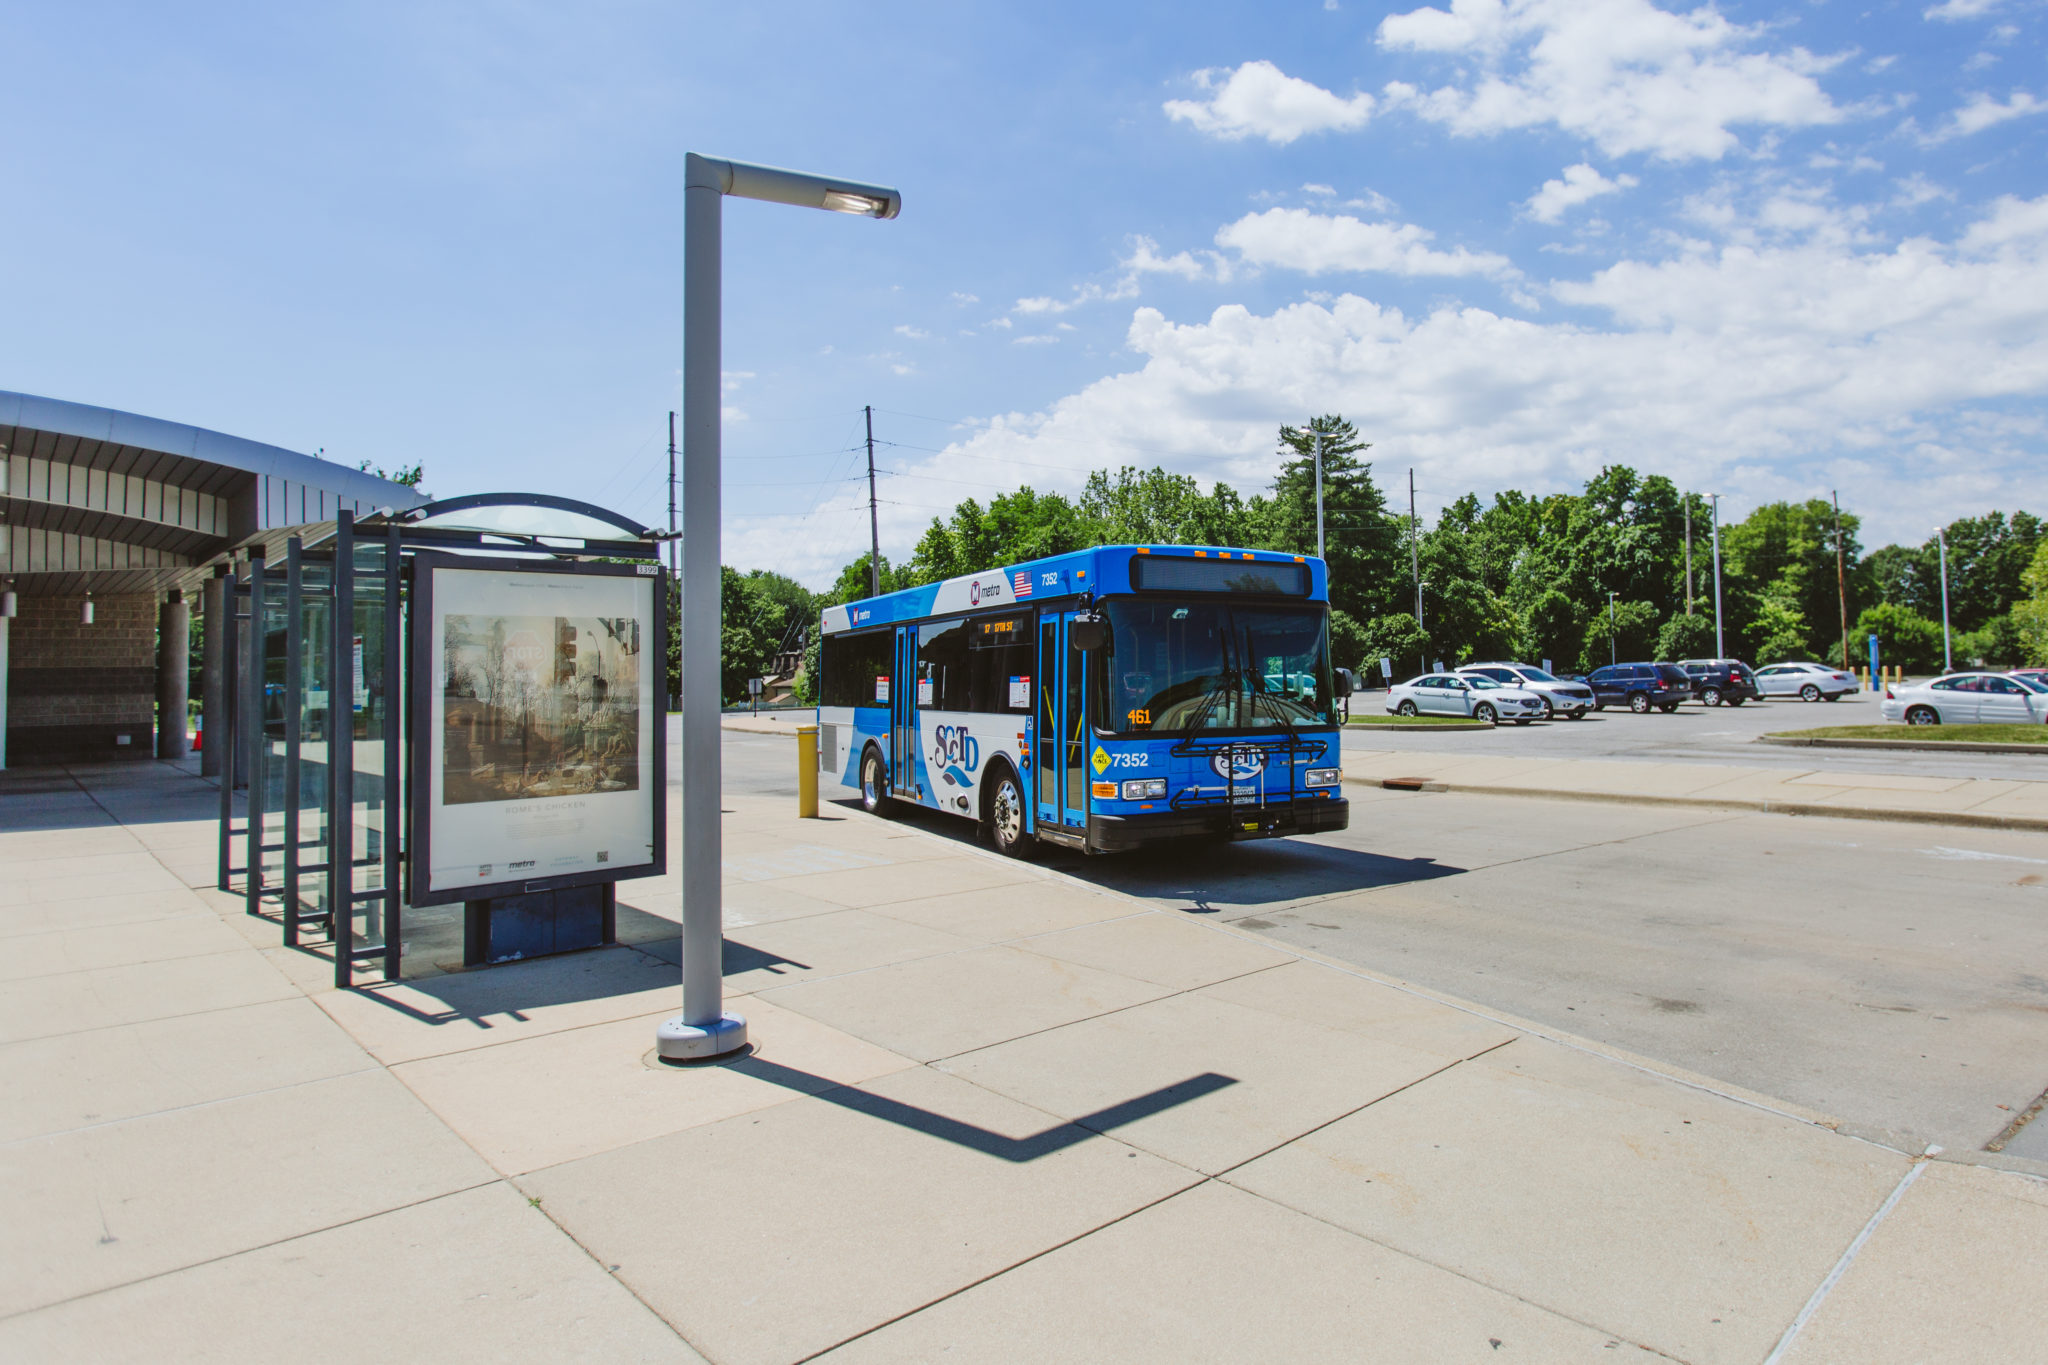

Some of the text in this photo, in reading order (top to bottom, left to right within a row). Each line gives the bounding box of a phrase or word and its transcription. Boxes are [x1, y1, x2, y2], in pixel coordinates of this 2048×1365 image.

[1041, 572, 1058, 586] 7352
[981, 584, 1000, 598] metro
[1128, 709, 1151, 724] 461
[1112, 753, 1148, 767] 7352
[544, 801, 586, 811] CHICKEN
[508, 860, 536, 869] metro
